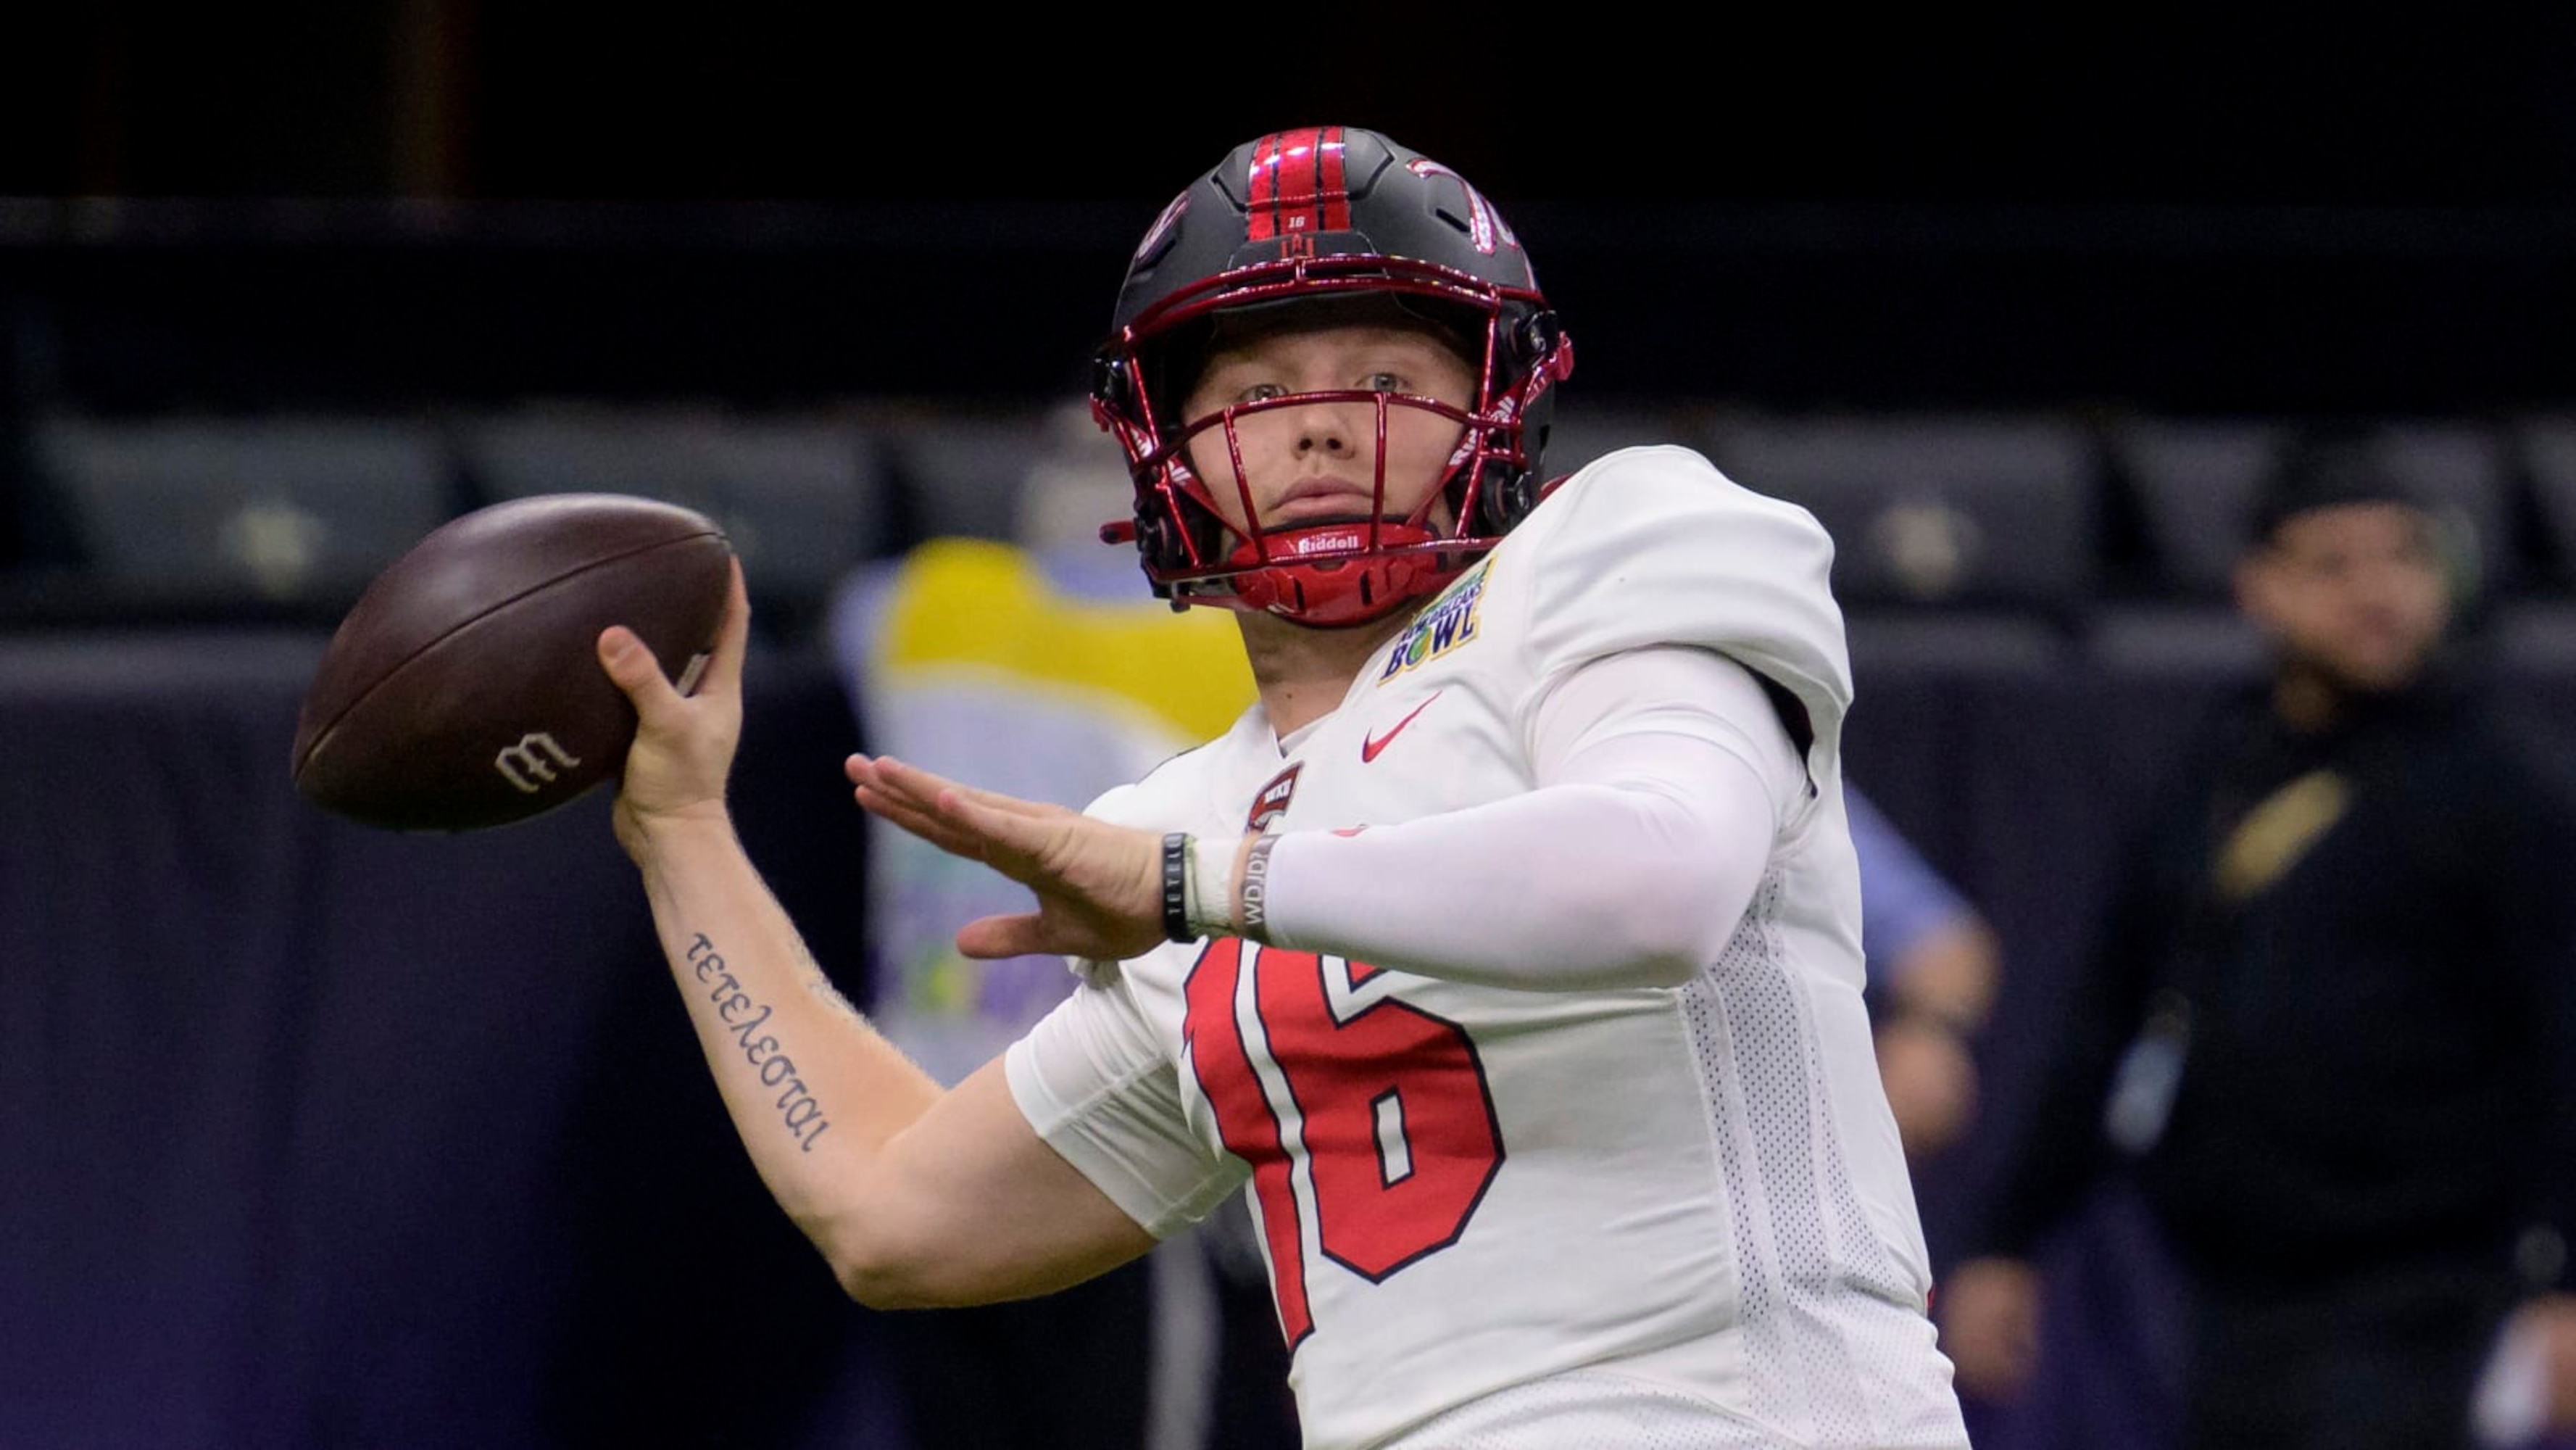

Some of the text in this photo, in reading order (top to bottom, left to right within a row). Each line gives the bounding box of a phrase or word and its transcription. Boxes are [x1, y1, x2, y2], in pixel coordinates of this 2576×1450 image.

[1288, 215, 1306, 229] 16
[1298, 535, 1359, 555] Riddell
[1379, 600, 1475, 681] BOWL
[1181, 935, 1506, 1354] 16
